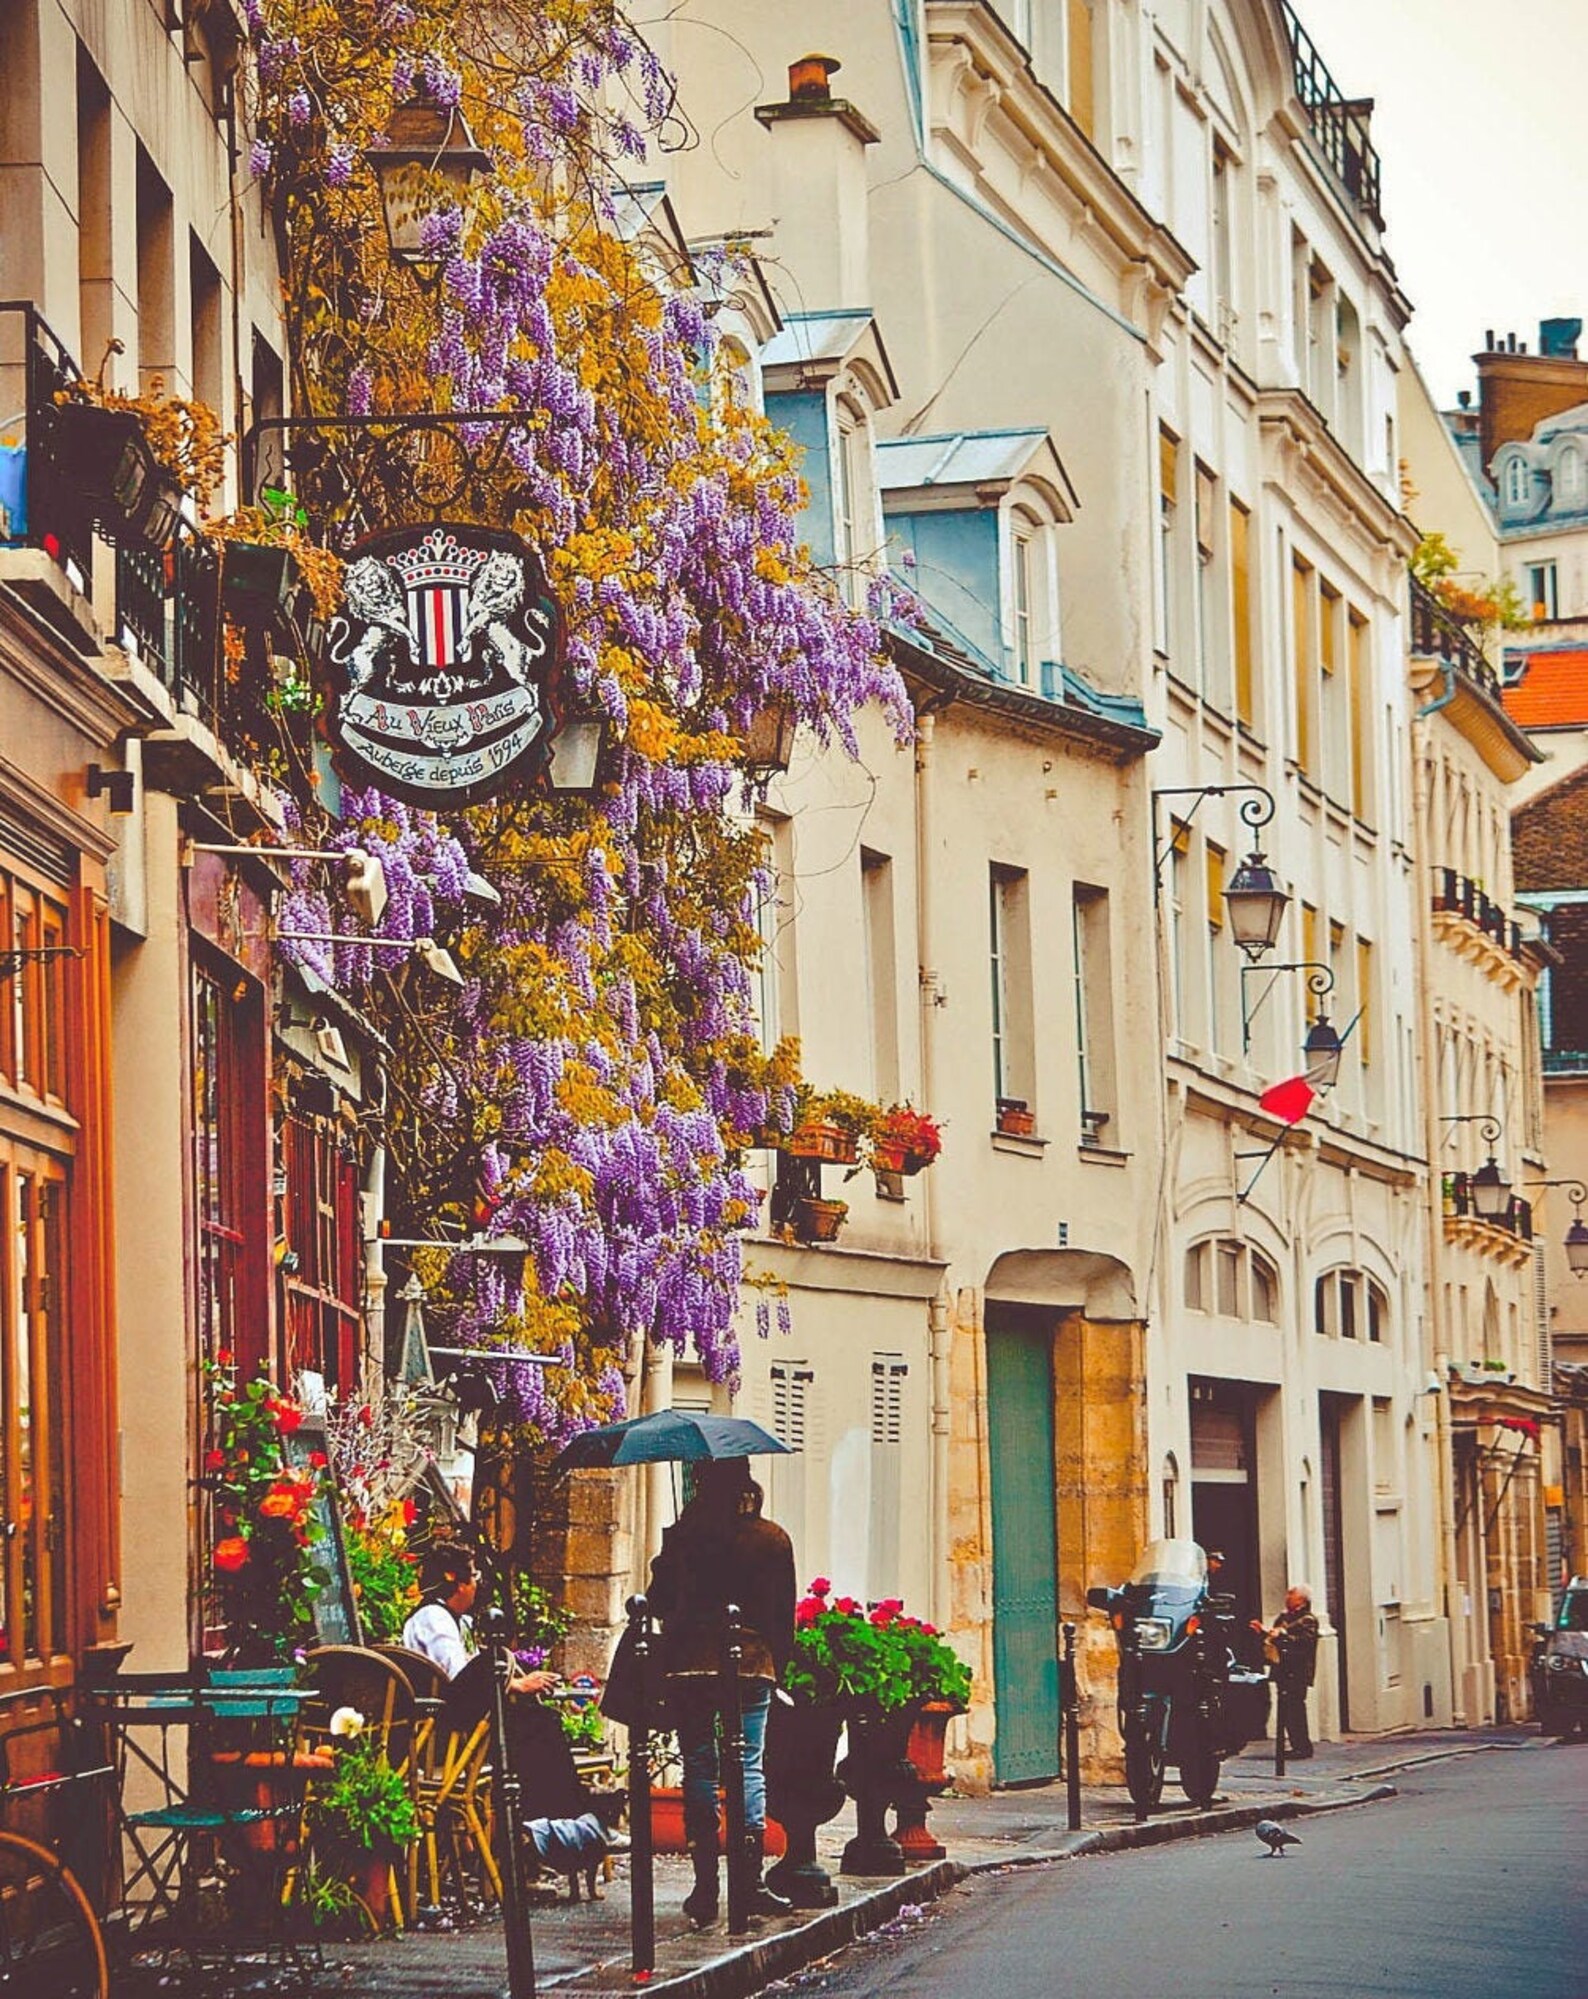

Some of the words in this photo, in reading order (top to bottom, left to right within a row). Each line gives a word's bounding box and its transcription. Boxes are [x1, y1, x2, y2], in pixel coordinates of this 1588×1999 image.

[365, 703, 402, 732] Au
[406, 709, 464, 737] Vieux
[465, 700, 516, 733] Paris
[356, 742, 425, 781] Auberge
[429, 757, 483, 784] depuis
[488, 733, 523, 769] 1594
